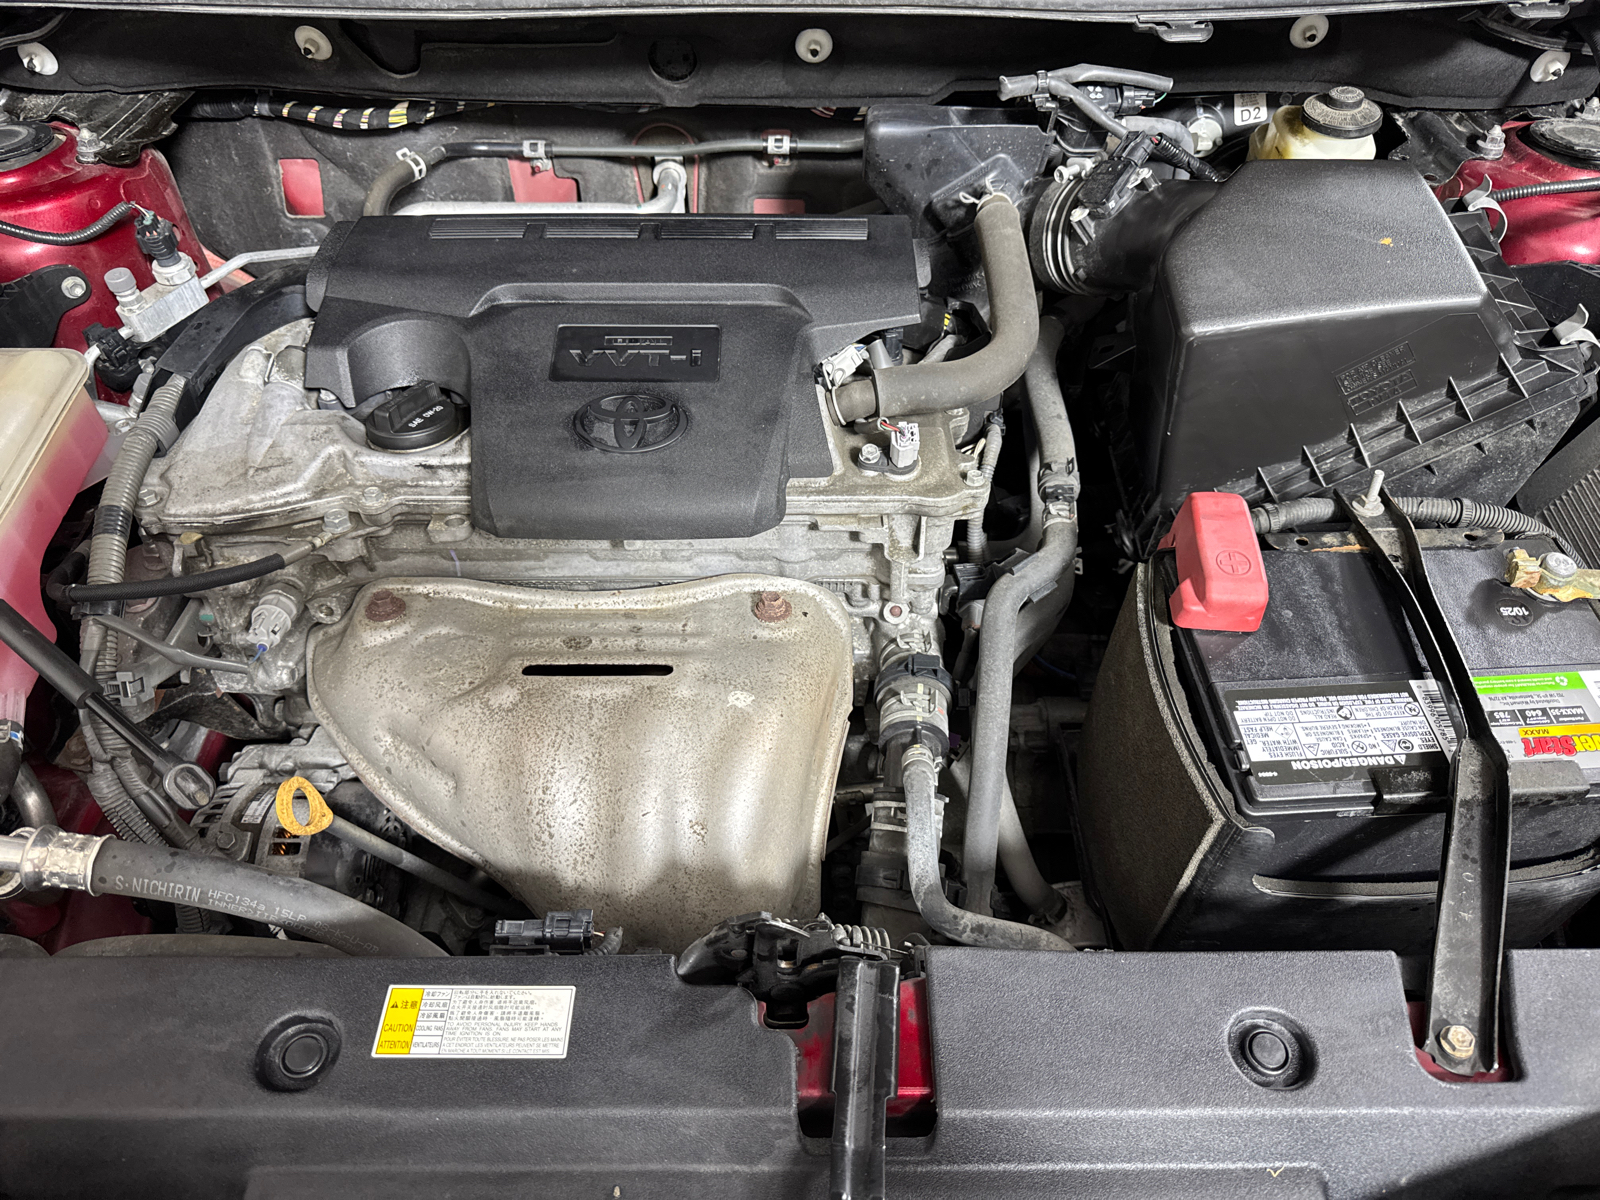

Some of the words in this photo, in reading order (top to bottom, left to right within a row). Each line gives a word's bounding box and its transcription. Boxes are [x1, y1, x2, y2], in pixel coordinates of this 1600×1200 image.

[1241, 106, 1261, 122] D2
[569, 350, 702, 366] VVT-i
[408, 417, 424, 428] SAE
[422, 406, 444, 418] 0W-20
[1500, 606, 1528, 615] 10/25
[1434, 720, 1449, 740] 05785
[1291, 756, 1396, 770] DANGER/POISON
[208, 889, 266, 911] HFC134a
[275, 907, 306, 921] 15LP
[400, 1000, 418, 1009] 注意
[384, 1024, 414, 1032] CAUTION
[379, 1040, 410, 1049] ATTENTION
